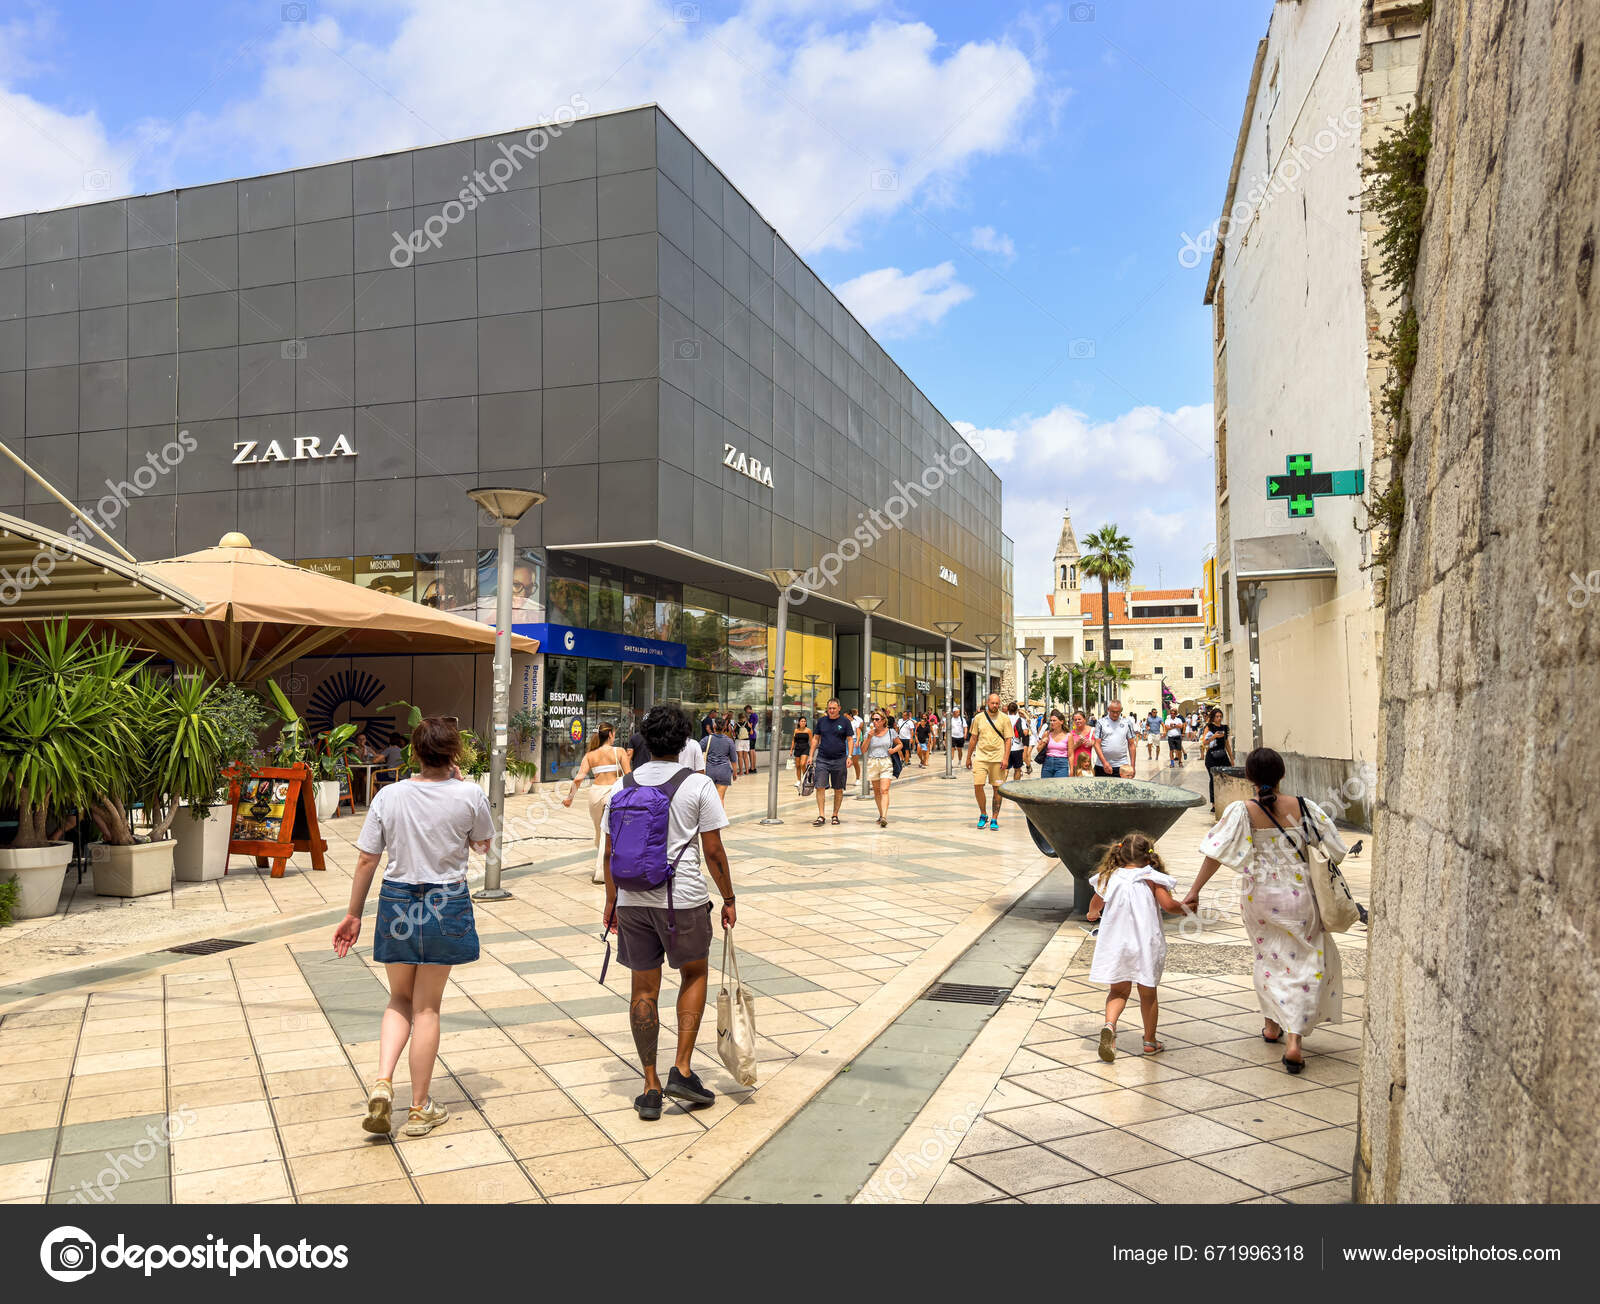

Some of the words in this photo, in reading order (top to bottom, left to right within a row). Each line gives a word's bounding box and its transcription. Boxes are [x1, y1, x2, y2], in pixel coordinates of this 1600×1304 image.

[232, 434, 359, 464] ZARA
[724, 443, 775, 489] ZARA
[370, 559, 401, 571] MOSCHINO
[939, 565, 958, 586] ZARA
[563, 630, 576, 651] G
[549, 692, 584, 702] BESPLATNA
[549, 705, 584, 716] KONTROLA
[549, 719, 565, 729] VIDA
